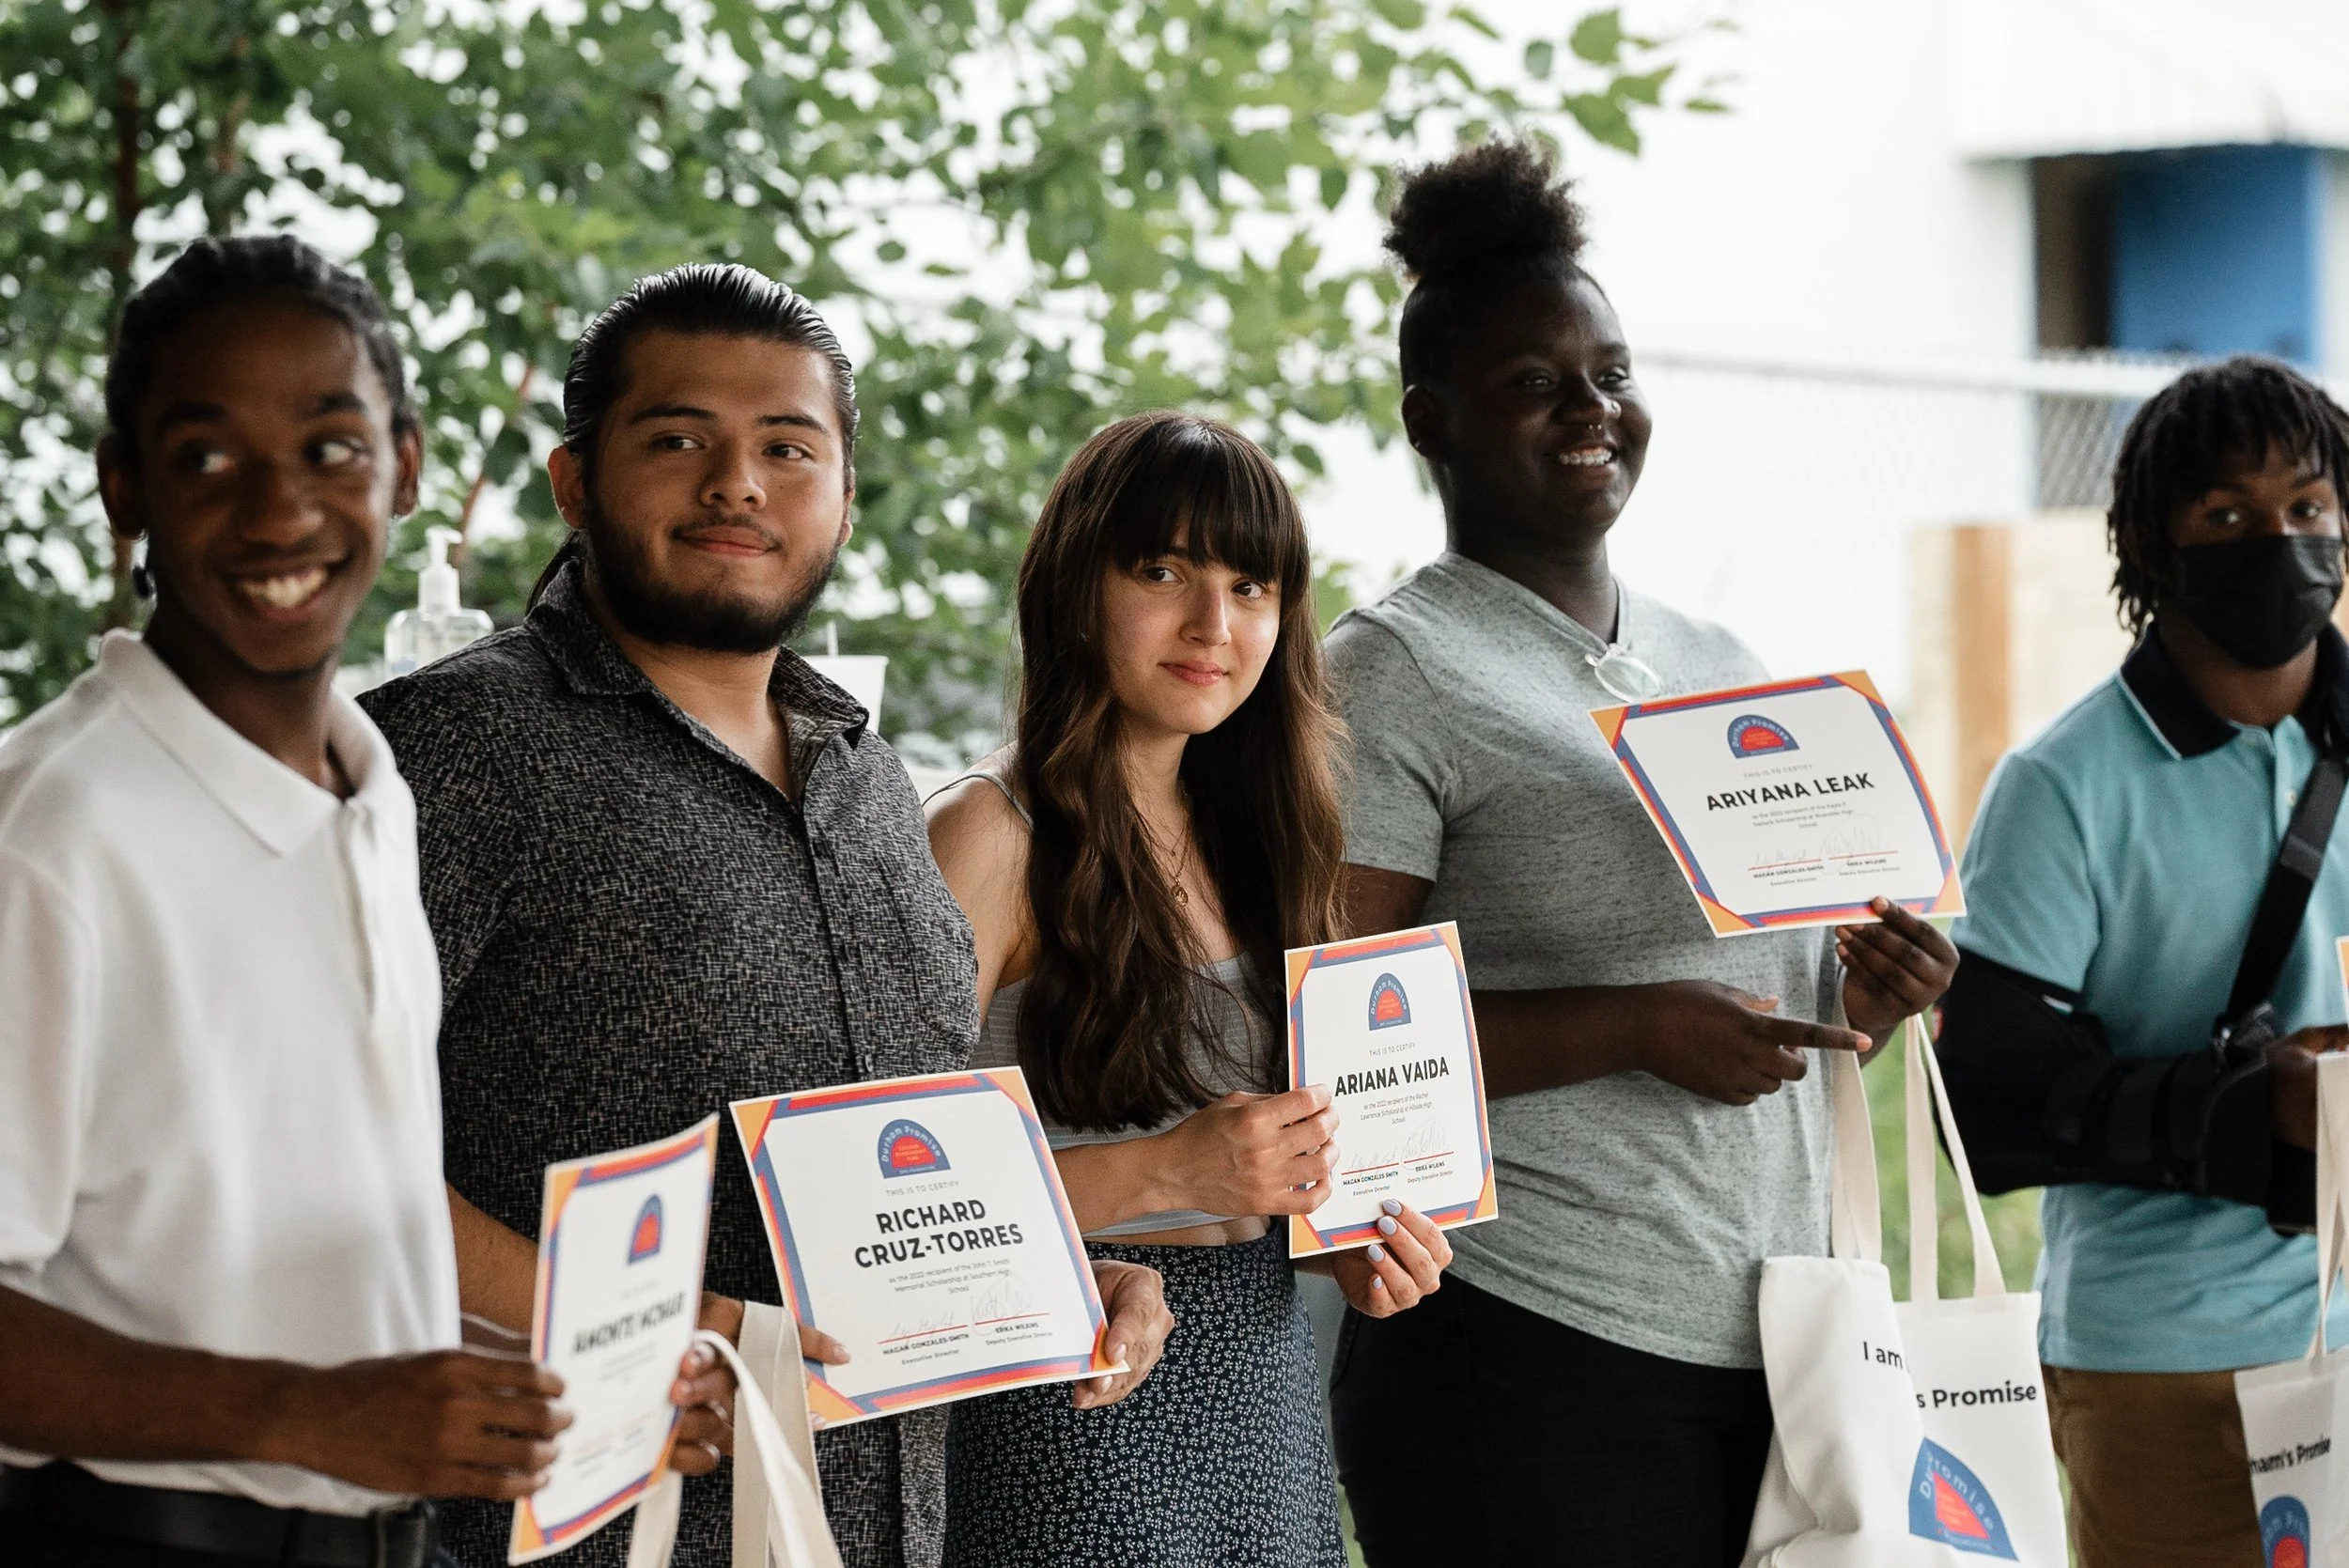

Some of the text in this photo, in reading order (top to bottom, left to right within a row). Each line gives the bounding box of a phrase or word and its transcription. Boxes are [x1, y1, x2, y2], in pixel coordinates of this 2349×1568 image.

[1706, 771, 1875, 811] ARIYANA LEAK
[1370, 981, 1387, 1015] Durham
[1388, 979, 1408, 1010] Promise
[1369, 1048, 1381, 1057] THIS
[1396, 1042, 1415, 1052] CERTIFY
[1334, 1056, 1450, 1097] ARIANA VAIDA
[1360, 1111, 1381, 1121] Lawrence
[1381, 1108, 1405, 1119] Scholarship
[1392, 1116, 1406, 1125] School
[881, 1127, 902, 1162] Durham
[904, 1126, 941, 1157] Promise
[1421, 1172, 1439, 1181] Executive
[1428, 1160, 1445, 1170] WILKINS
[885, 1188, 905, 1197] THIS
[928, 1180, 959, 1191] CERTIFY
[1353, 1188, 1374, 1197] Executive
[875, 1199, 986, 1234] RICHARD
[854, 1223, 1024, 1268] CRUZ-TORRES
[1862, 1341, 1904, 1370] I am
[1932, 1379, 2037, 1409] Promise
